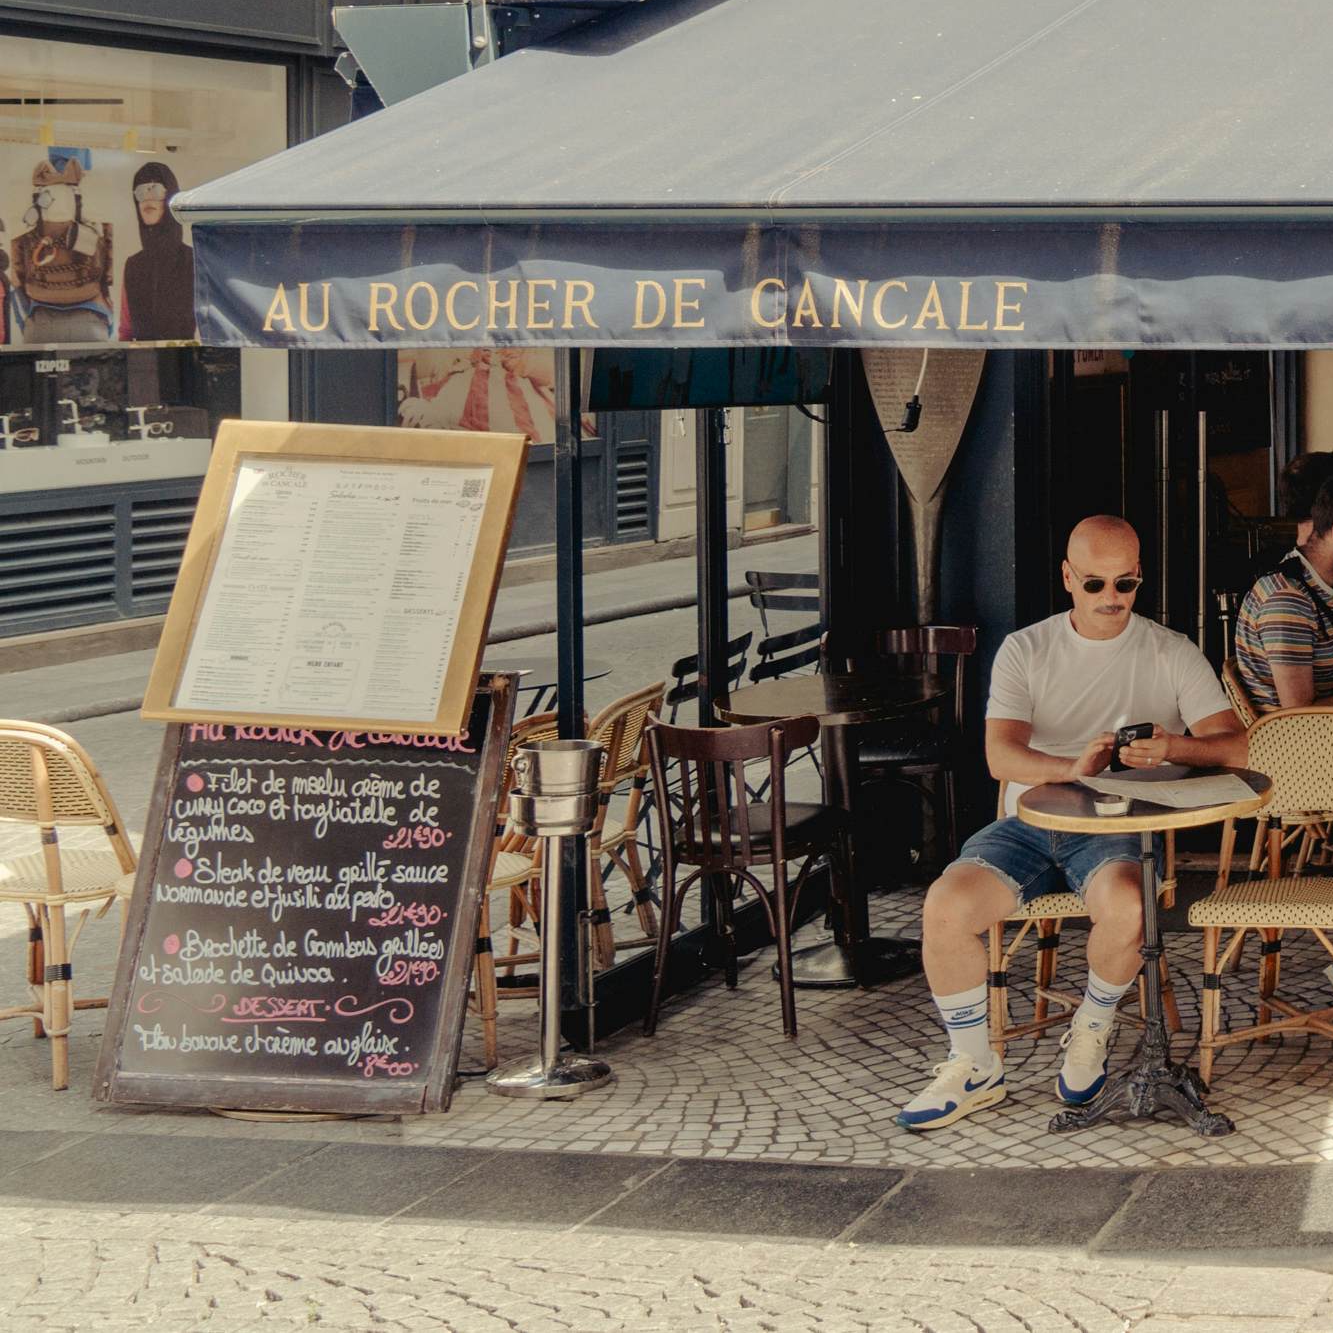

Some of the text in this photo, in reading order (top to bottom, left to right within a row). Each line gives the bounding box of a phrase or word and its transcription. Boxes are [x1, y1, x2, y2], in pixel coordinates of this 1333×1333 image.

[262, 277, 1028, 333] AU ROCHER DE CANCALE
[207, 767, 257, 794] Filet
[261, 769, 286, 794] de
[351, 772, 406, 799] crème
[409, 773, 441, 799] de
[227, 798, 265, 816] coco
[268, 796, 292, 821] et
[293, 796, 398, 839] tagliatelle
[408, 801, 440, 827] de
[167, 817, 255, 860] légumes
[193, 851, 450, 894] Steak de veau grillé sauce
[251, 886, 275, 909] et
[271, 884, 322, 923] fusilli
[140, 954, 162, 987] et
[230, 963, 260, 987] de
[180, 926, 445, 977] Brochette de Gambas grillées
[232, 997, 325, 1017] DESSERT
[133, 1023, 177, 1053] Flan
[244, 1024, 268, 1054] et
